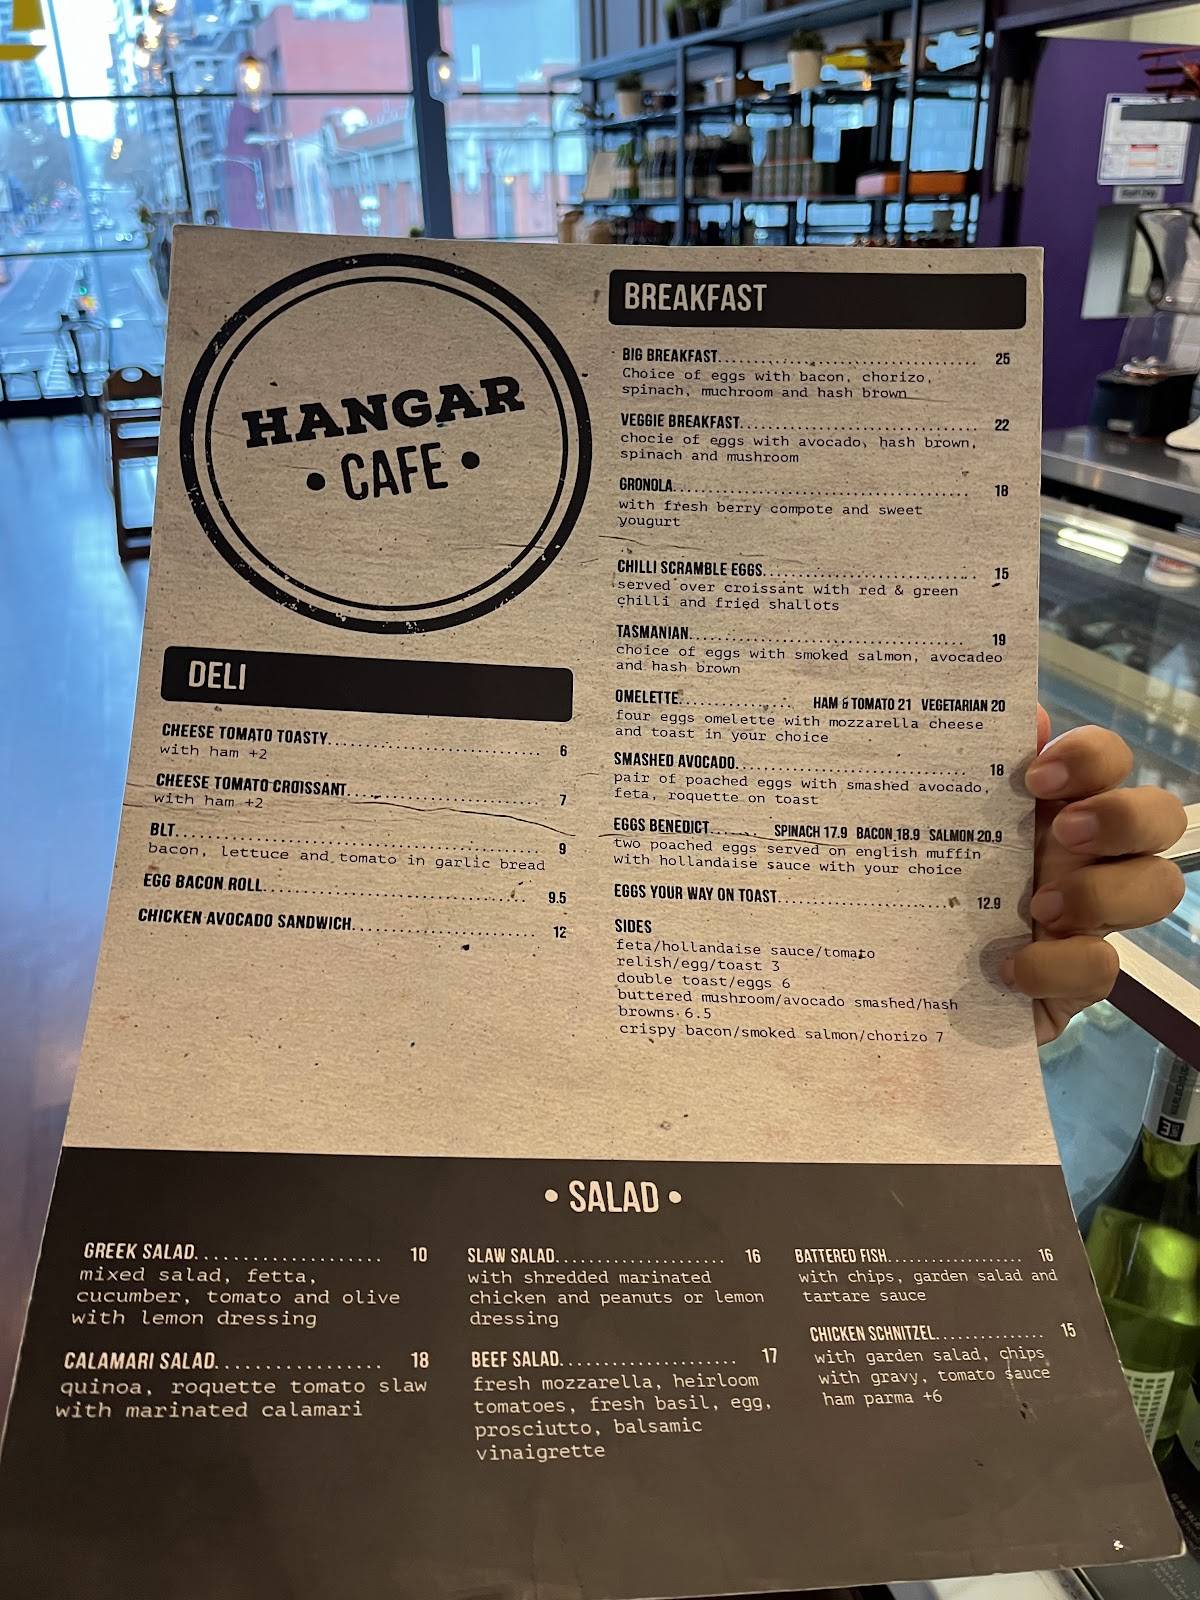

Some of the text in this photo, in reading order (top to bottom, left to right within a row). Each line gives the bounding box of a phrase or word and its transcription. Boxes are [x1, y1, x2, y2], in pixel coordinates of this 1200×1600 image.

[626, 283, 766, 310] BREAKFAST
[623, 348, 642, 360] BIG
[996, 353, 1010, 364] 25
[242, 376, 524, 449] HANGAR
[621, 413, 664, 426] VEGGIE
[995, 419, 1009, 431] 22
[341, 442, 448, 500] CAFE
[995, 485, 1008, 496] 18
[619, 499, 922, 516] with fresh berry compote and sweet
[618, 516, 680, 528] yougurt
[618, 560, 656, 573] CHILLI
[661, 561, 727, 576] SCRAMBLE
[995, 568, 1008, 579] 15
[993, 634, 1005, 645] 19
[189, 661, 245, 689] DELI
[814, 697, 838, 708] HAM
[843, 697, 848, 709] &
[851, 698, 894, 710] TOMATO
[898, 699, 911, 710] 21
[922, 699, 987, 711] VEGETARIAN
[992, 700, 1005, 712] 20
[616, 710, 983, 729] four eggs omelette with mozzarella cheese
[162, 723, 214, 738] CHEESE
[220, 726, 272, 742] TOMATO
[560, 745, 567, 756] 6
[160, 744, 266, 759] with ham +2
[614, 752, 673, 766] SMASHED
[990, 764, 1004, 776] 18
[156, 774, 209, 788] CHEESE
[215, 776, 268, 792] TOMATO
[560, 794, 566, 806] 7
[614, 818, 645, 831] EGGS
[775, 824, 820, 837] SPINACH
[824, 826, 847, 838] 17.9
[857, 827, 892, 839] BACON
[896, 828, 920, 840] 18.9
[930, 829, 974, 842] SALMON
[978, 830, 1002, 842] 20.9
[149, 842, 545, 870] bacon, lettuce and tomato in garlic bread
[560, 843, 566, 854] 9
[614, 839, 980, 859] two poached eggs served on english muffin
[144, 874, 170, 887] EGG
[176, 875, 223, 890] BACON
[549, 892, 566, 904] 9.5
[615, 884, 646, 898] EGGS
[651, 885, 682, 899] YOUR
[688, 887, 713, 900] WAY
[718, 888, 734, 901] ON
[978, 897, 1000, 909] 12.9
[138, 908, 202, 924] CHICKEN
[206, 912, 272, 927] AVOCADO
[554, 926, 566, 938] 12
[615, 919, 651, 933] SIDES
[617, 939, 874, 959] feta/hollandaise sauce/tomato
[617, 956, 779, 971] relish/egg/toast 3
[618, 972, 790, 990] double toast/eggs 6
[618, 989, 958, 1010] buttered mushroom/avocado smashed/hash
[618, 1005, 711, 1018] browns 6.5
[620, 1023, 943, 1042] crispy bacon/smoked salmon/chorizo 7
[569, 1180, 658, 1212] SALAD
[84, 1243, 137, 1258] GREEK
[411, 1247, 427, 1262] 10
[468, 1248, 505, 1262] SLAW
[746, 1249, 760, 1263] 16
[795, 1249, 856, 1262] BATTERED
[1038, 1249, 1053, 1261] 16
[80, 1266, 314, 1284] mixed salad, fetta,
[468, 1270, 711, 1283] with shredded marinated
[803, 1292, 926, 1302] tartare sauce
[72, 1310, 316, 1328] with lemon dressing
[810, 1326, 865, 1341] CHICKEN
[1061, 1323, 1076, 1337] 15
[64, 1352, 154, 1369] CALAMARI
[411, 1352, 428, 1368] 18
[472, 1352, 507, 1367] BEEF
[762, 1348, 776, 1363] 17
[474, 1373, 759, 1391] fresh mozzarella, heirloom
[818, 1369, 1050, 1386] with gravy, tomato sauce
[822, 1389, 942, 1407] ham parma +6
[475, 1419, 702, 1440] prosciutto, balsamic
[477, 1444, 604, 1462] vinaigrette
